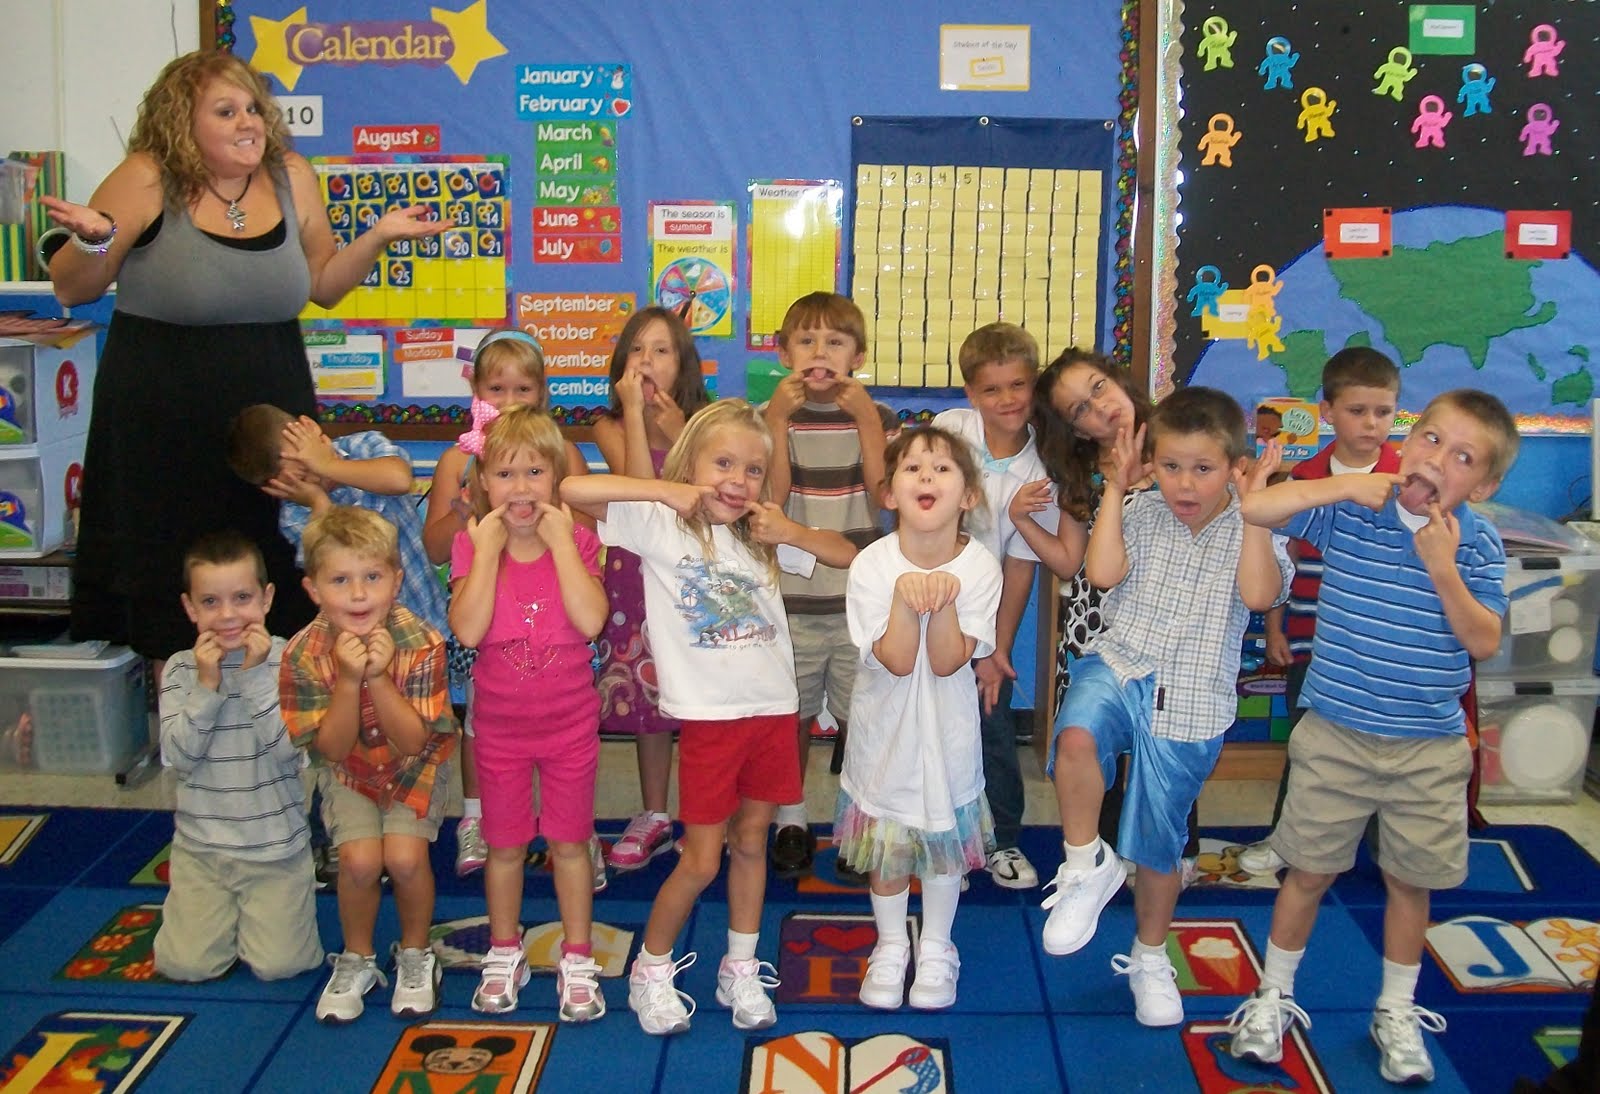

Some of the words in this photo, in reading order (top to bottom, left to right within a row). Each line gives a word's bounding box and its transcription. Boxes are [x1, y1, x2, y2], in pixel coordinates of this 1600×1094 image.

[292, 25, 450, 62] Calendar
[520, 66, 594, 88] January
[520, 94, 604, 116] February
[356, 128, 420, 151] August
[538, 123, 593, 141] March
[540, 153, 583, 175] April
[939, 172, 947, 183] 4
[963, 172, 972, 185] 5
[343, 184, 351, 198] 2
[373, 182, 381, 196] 3
[399, 182, 407, 195] 4
[430, 180, 438, 194] 5
[463, 178, 473, 192] 6
[494, 180, 501, 194] 7
[540, 181, 580, 203] May
[759, 187, 798, 198] Weather
[342, 213, 349, 227] 9
[366, 214, 379, 227] 10
[456, 211, 470, 225] 13
[486, 211, 500, 226] 14
[538, 209, 579, 227] June
[662, 208, 678, 218] The
[682, 210, 716, 218] season
[718, 208, 725, 218] is
[669, 222, 707, 233] summer
[396, 239, 410, 254] 18
[426, 241, 439, 255] 19
[453, 242, 469, 256] 20
[487, 239, 501, 255] 21
[538, 238, 575, 260] July
[658, 243, 675, 254] The
[677, 244, 717, 254] weather
[720, 243, 729, 254] is
[396, 270, 410, 285] 25
[520, 294, 615, 315] September
[304, 332, 343, 345] dnesday
[405, 328, 443, 341] Sunday
[524, 323, 598, 340] October
[327, 353, 373, 366] Thursday
[404, 347, 443, 358] Monday
[543, 350, 610, 368] vember
[63, 374, 72, 398] K
[1451, 920, 1532, 979] J
[755, 1035, 843, 1094] N
